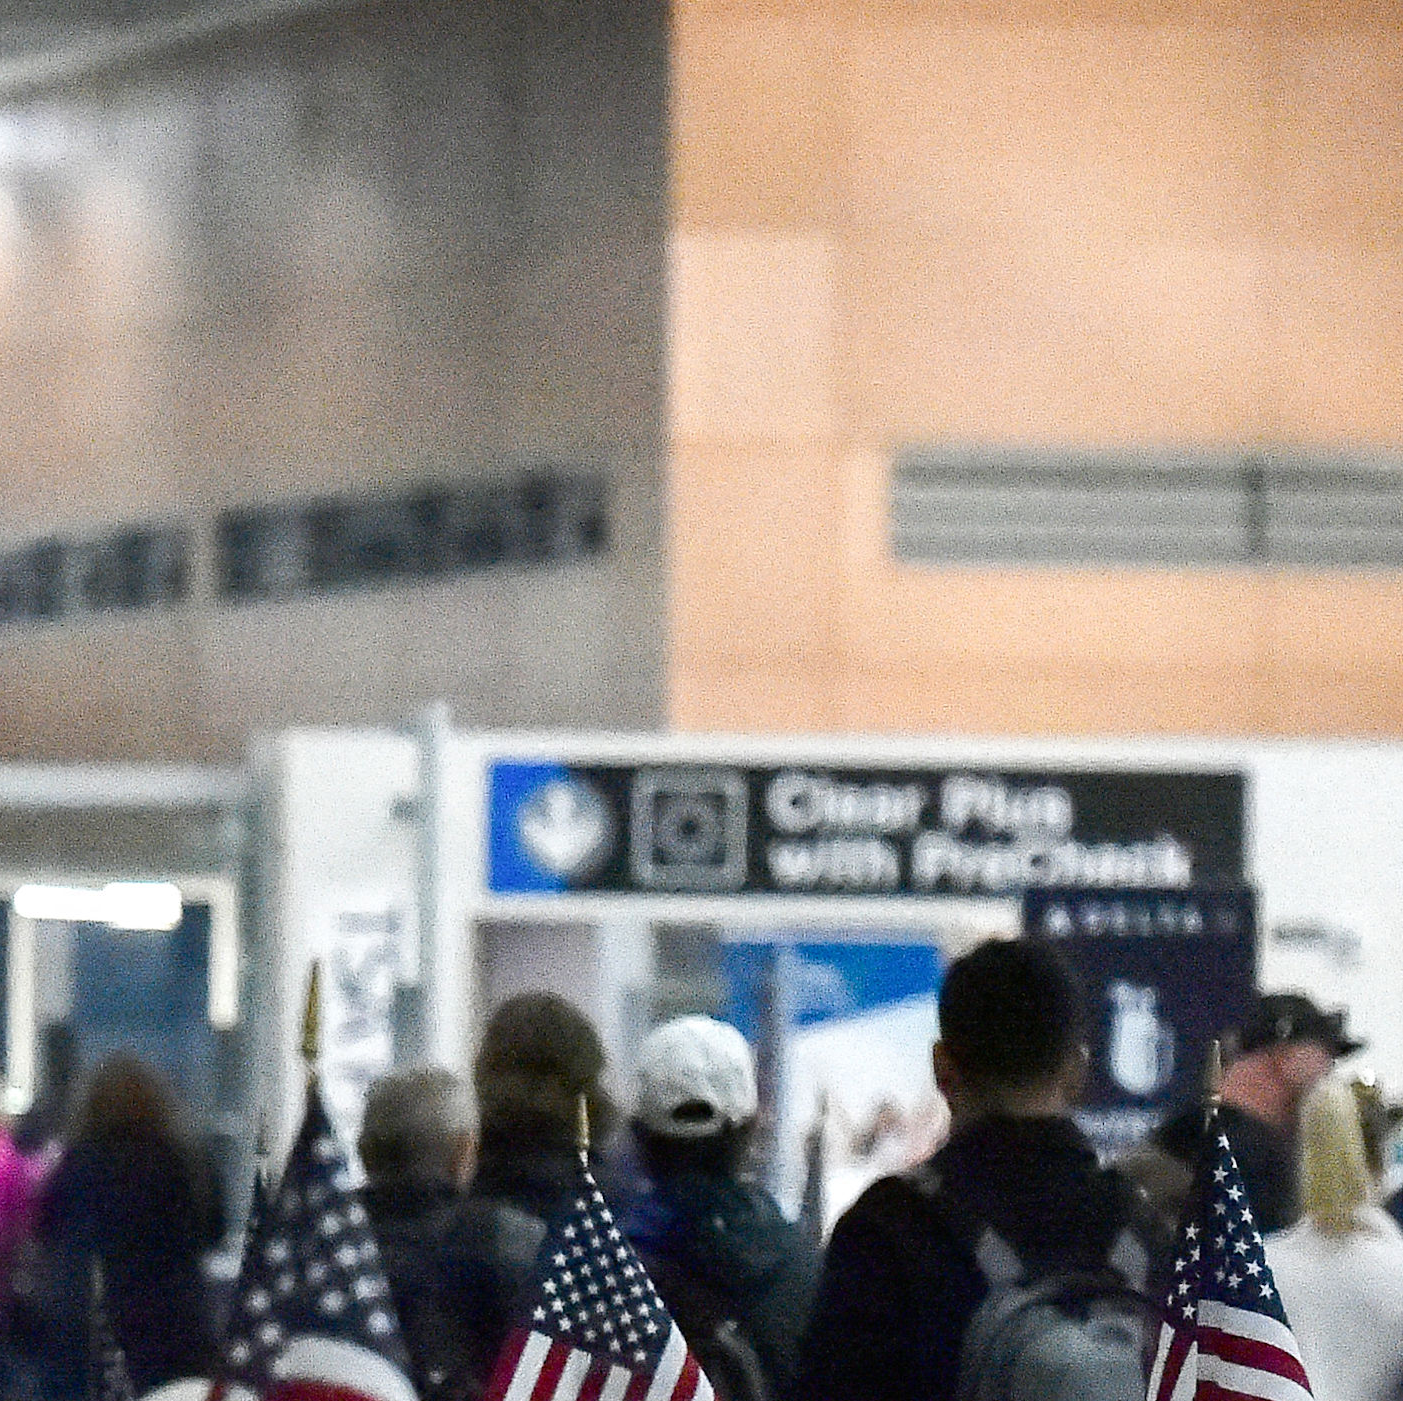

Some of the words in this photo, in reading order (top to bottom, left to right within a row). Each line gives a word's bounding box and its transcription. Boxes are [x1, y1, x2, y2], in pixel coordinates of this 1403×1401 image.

[764, 771, 925, 833] Clear
[939, 772, 1074, 836] Plus
[766, 834, 902, 888] with
